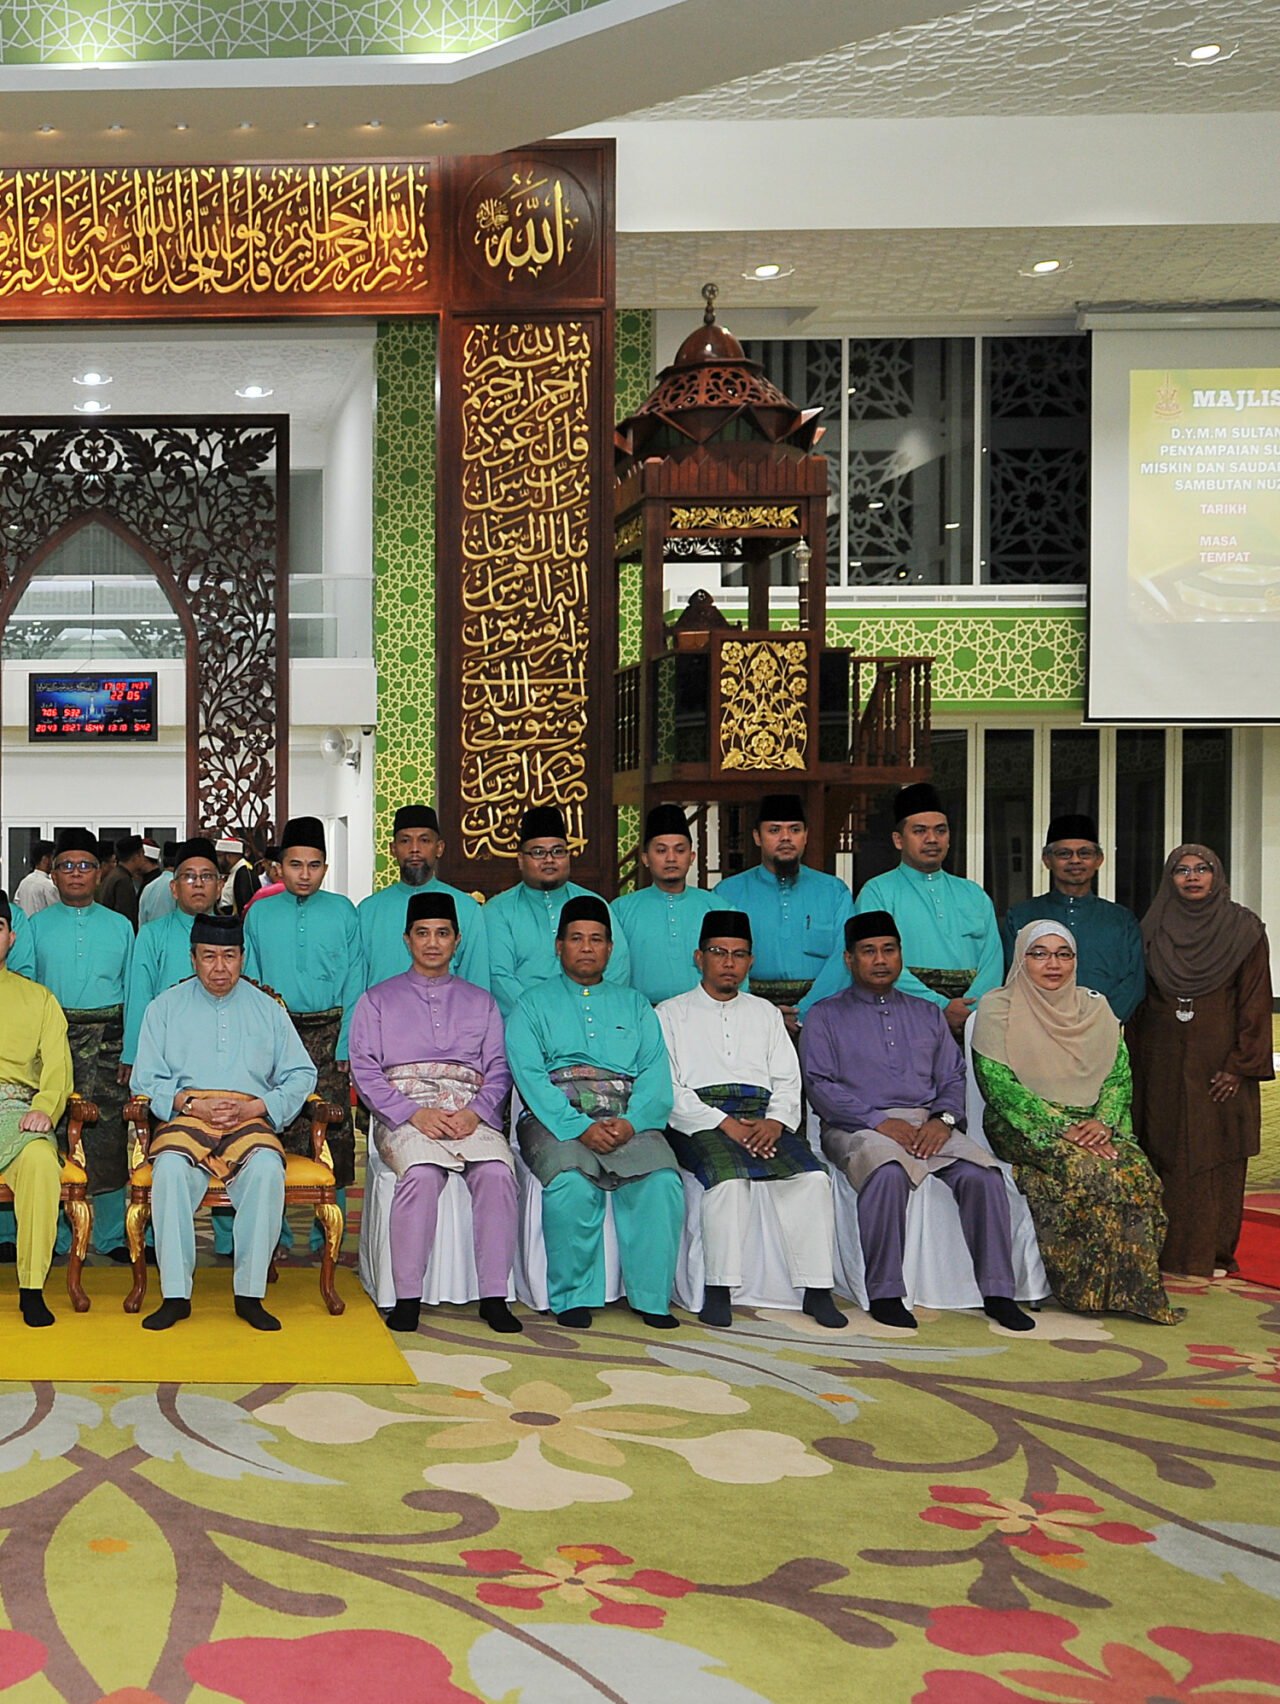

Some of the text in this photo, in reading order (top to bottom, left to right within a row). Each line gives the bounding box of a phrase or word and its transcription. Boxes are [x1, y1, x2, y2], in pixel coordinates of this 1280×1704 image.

[1193, 390, 1280, 411] MAJLIS
[1171, 428, 1227, 439] D.Y.M.M
[1160, 445, 1259, 456] PENYAMPAIAN
[1141, 463, 1192, 474] MISKIN
[1196, 462, 1225, 473] DAN
[1175, 479, 1252, 490] SAMBUTAN
[1200, 503, 1247, 514] TARIKH
[1200, 536, 1237, 546] MASA
[1200, 552, 1251, 562] TEMPAT
